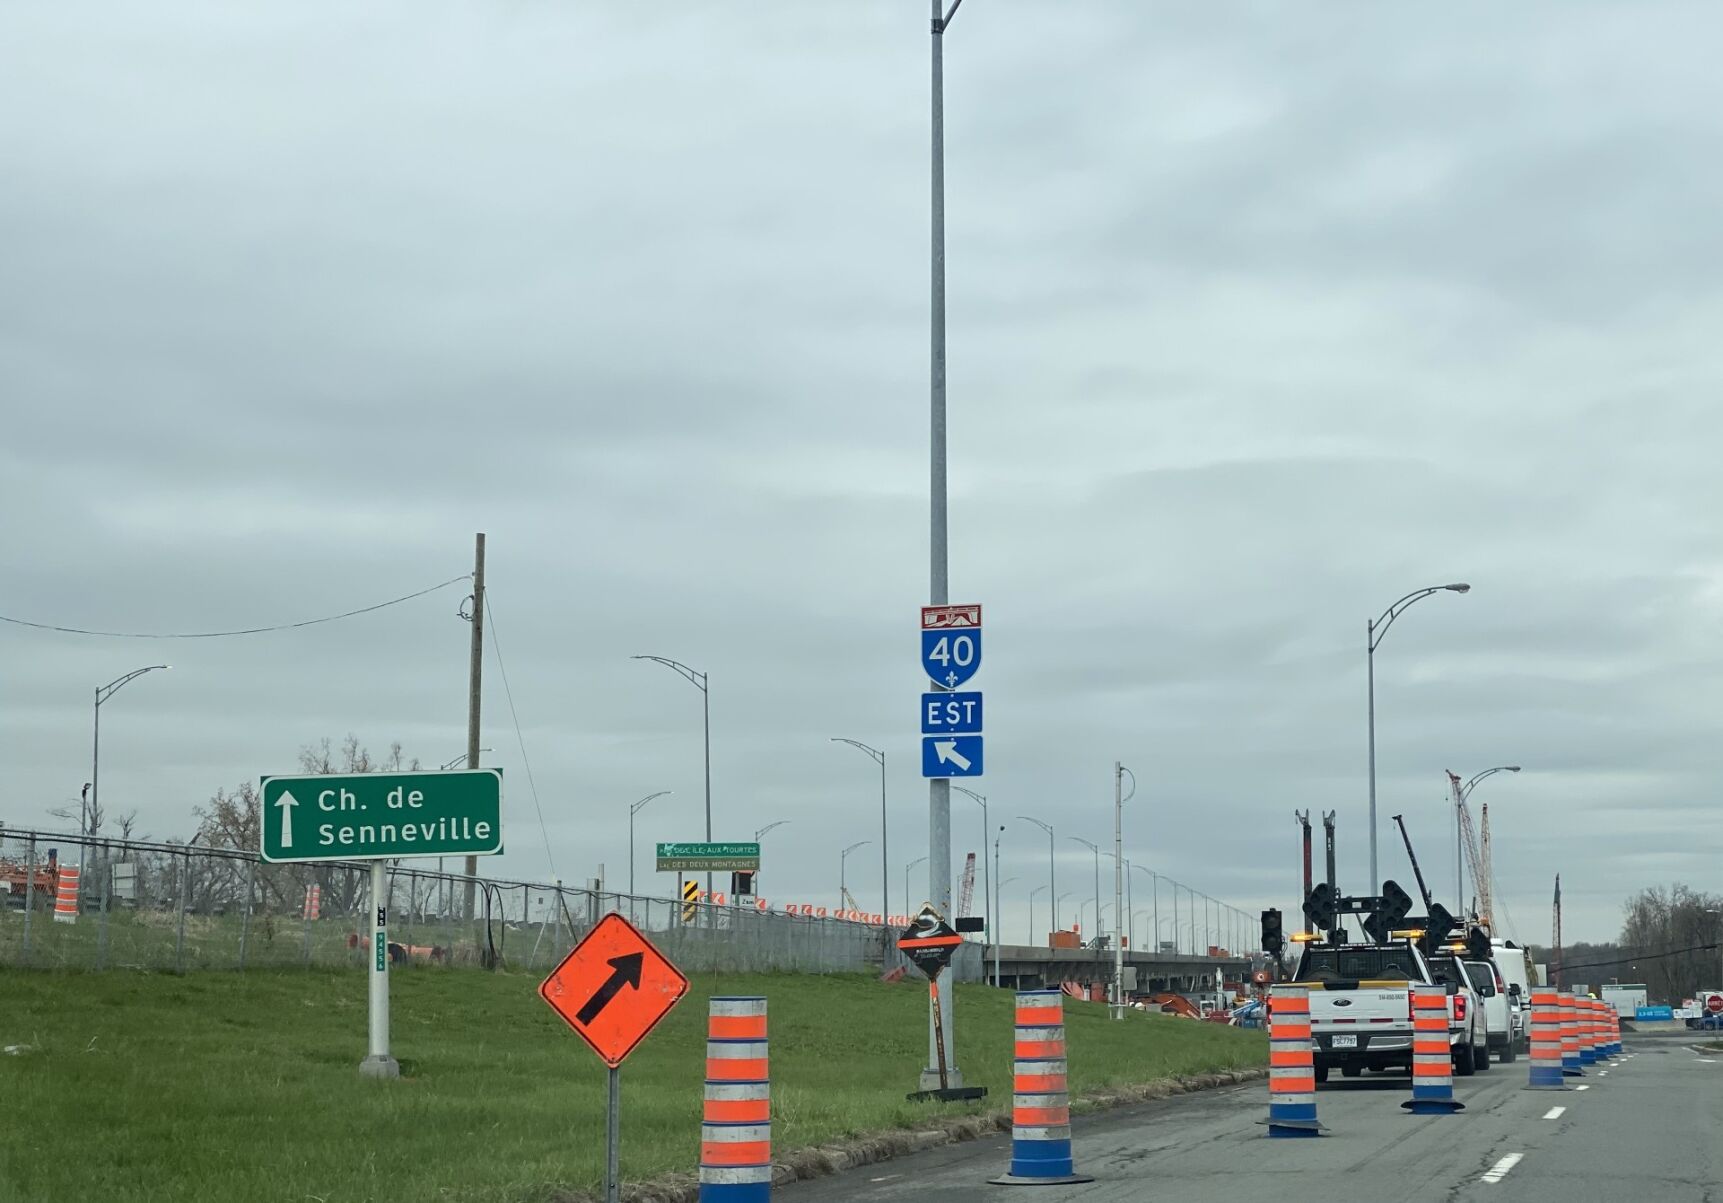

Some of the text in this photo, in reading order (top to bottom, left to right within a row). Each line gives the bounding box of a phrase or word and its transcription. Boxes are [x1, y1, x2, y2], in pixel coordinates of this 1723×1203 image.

[929, 636, 974, 667] 40
[928, 701, 976, 725] EST
[318, 786, 424, 811] Ch. de
[319, 817, 491, 845] Senneville
